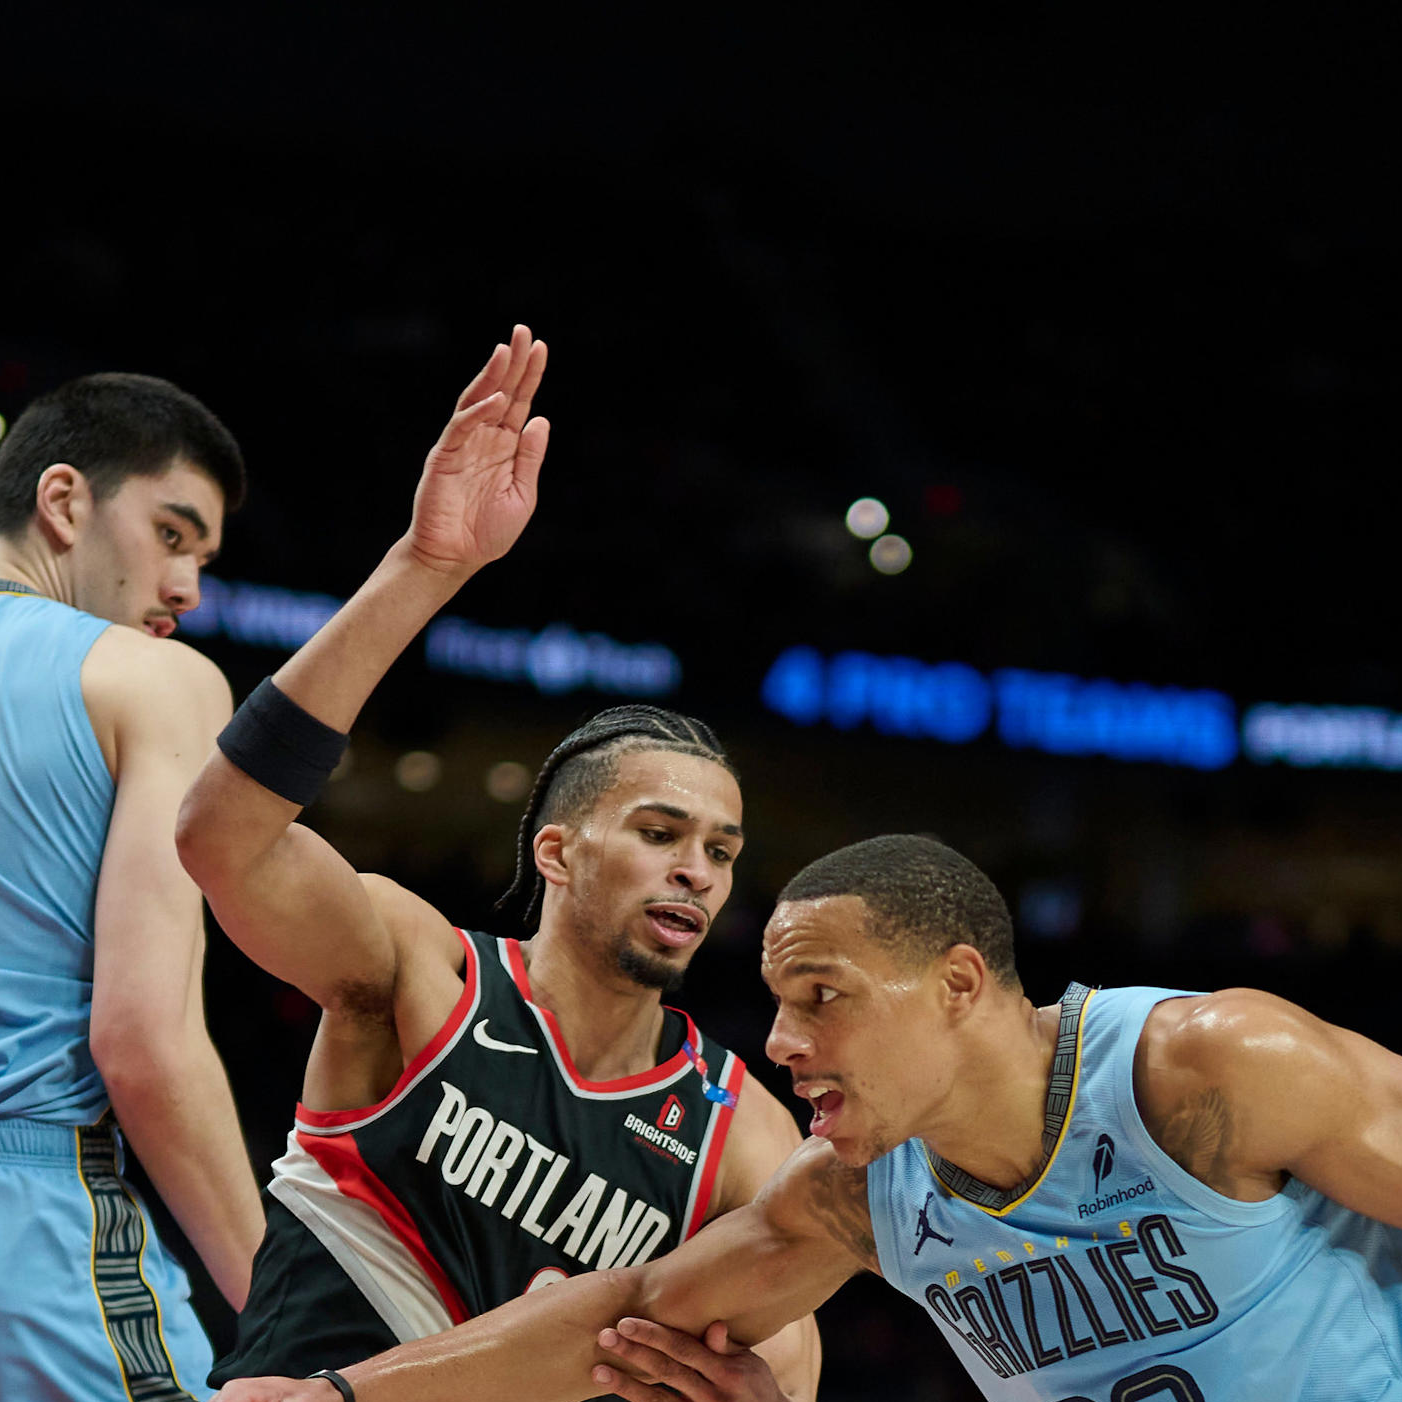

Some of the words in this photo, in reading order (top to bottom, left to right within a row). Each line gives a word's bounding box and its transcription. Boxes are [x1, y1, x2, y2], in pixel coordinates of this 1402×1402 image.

[415, 1081, 671, 1270] PORTLAND
[623, 1113, 698, 1165] BRIGHTSIDE
[1078, 1176, 1156, 1219] Robinhood
[925, 1214, 1219, 1379] GRIZZLIES
